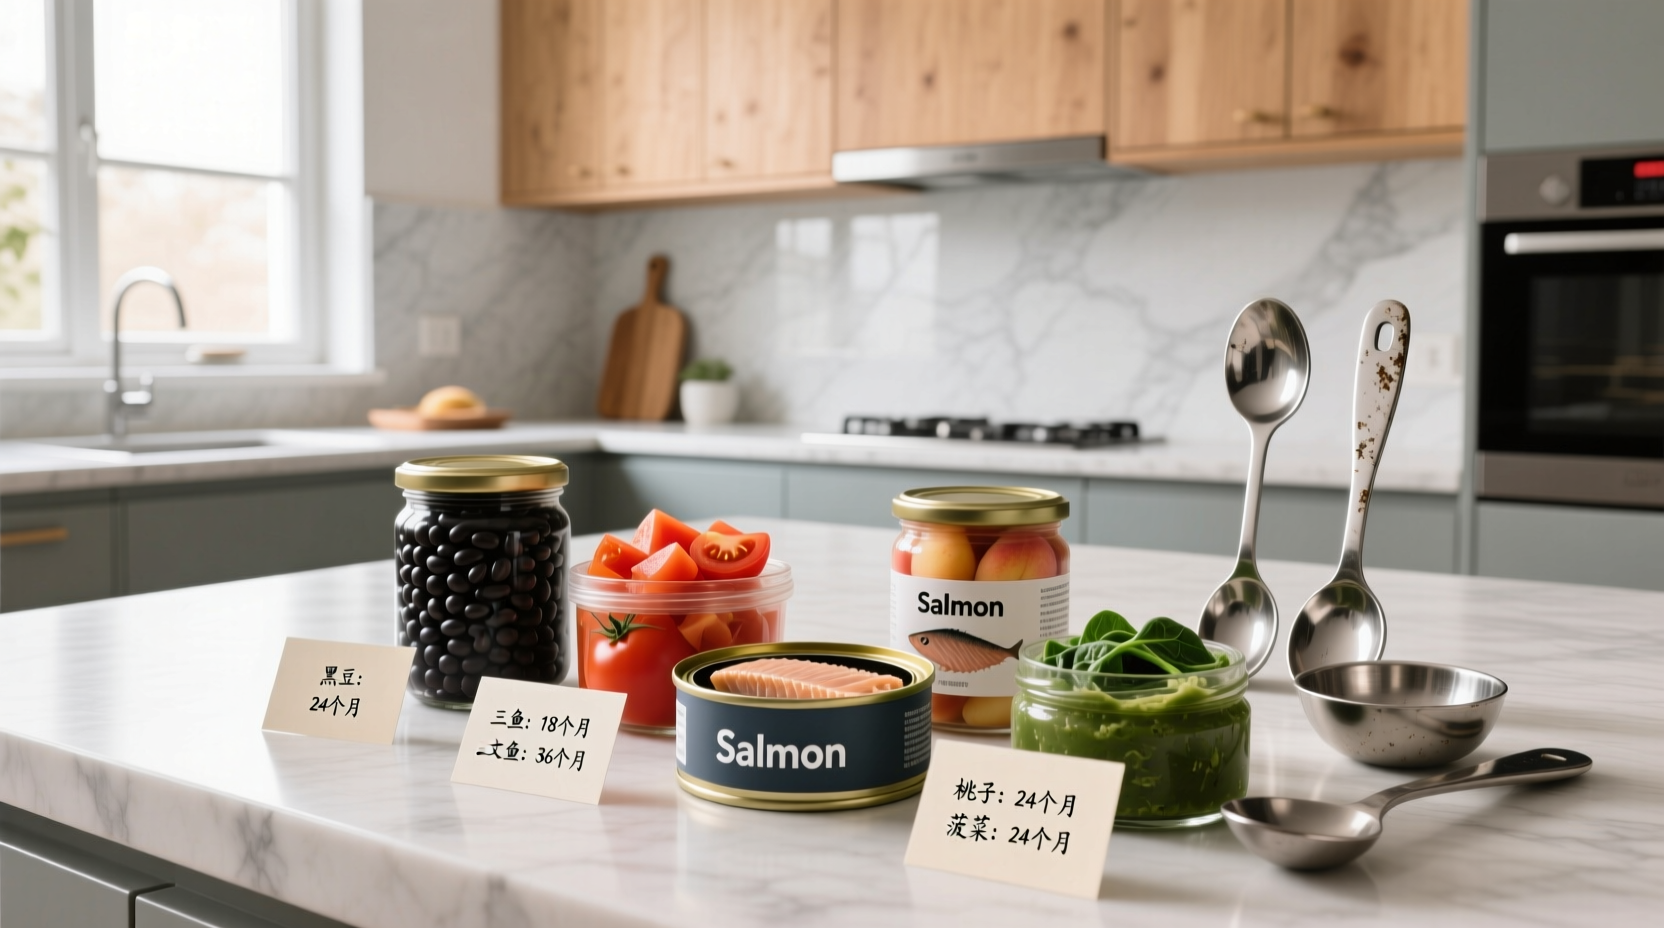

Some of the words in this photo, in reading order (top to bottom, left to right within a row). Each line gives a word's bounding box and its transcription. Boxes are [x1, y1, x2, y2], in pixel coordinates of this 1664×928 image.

[917, 591, 1004, 618] Salmon
[309, 694, 361, 718] 24个月
[715, 728, 847, 770] Salmon
